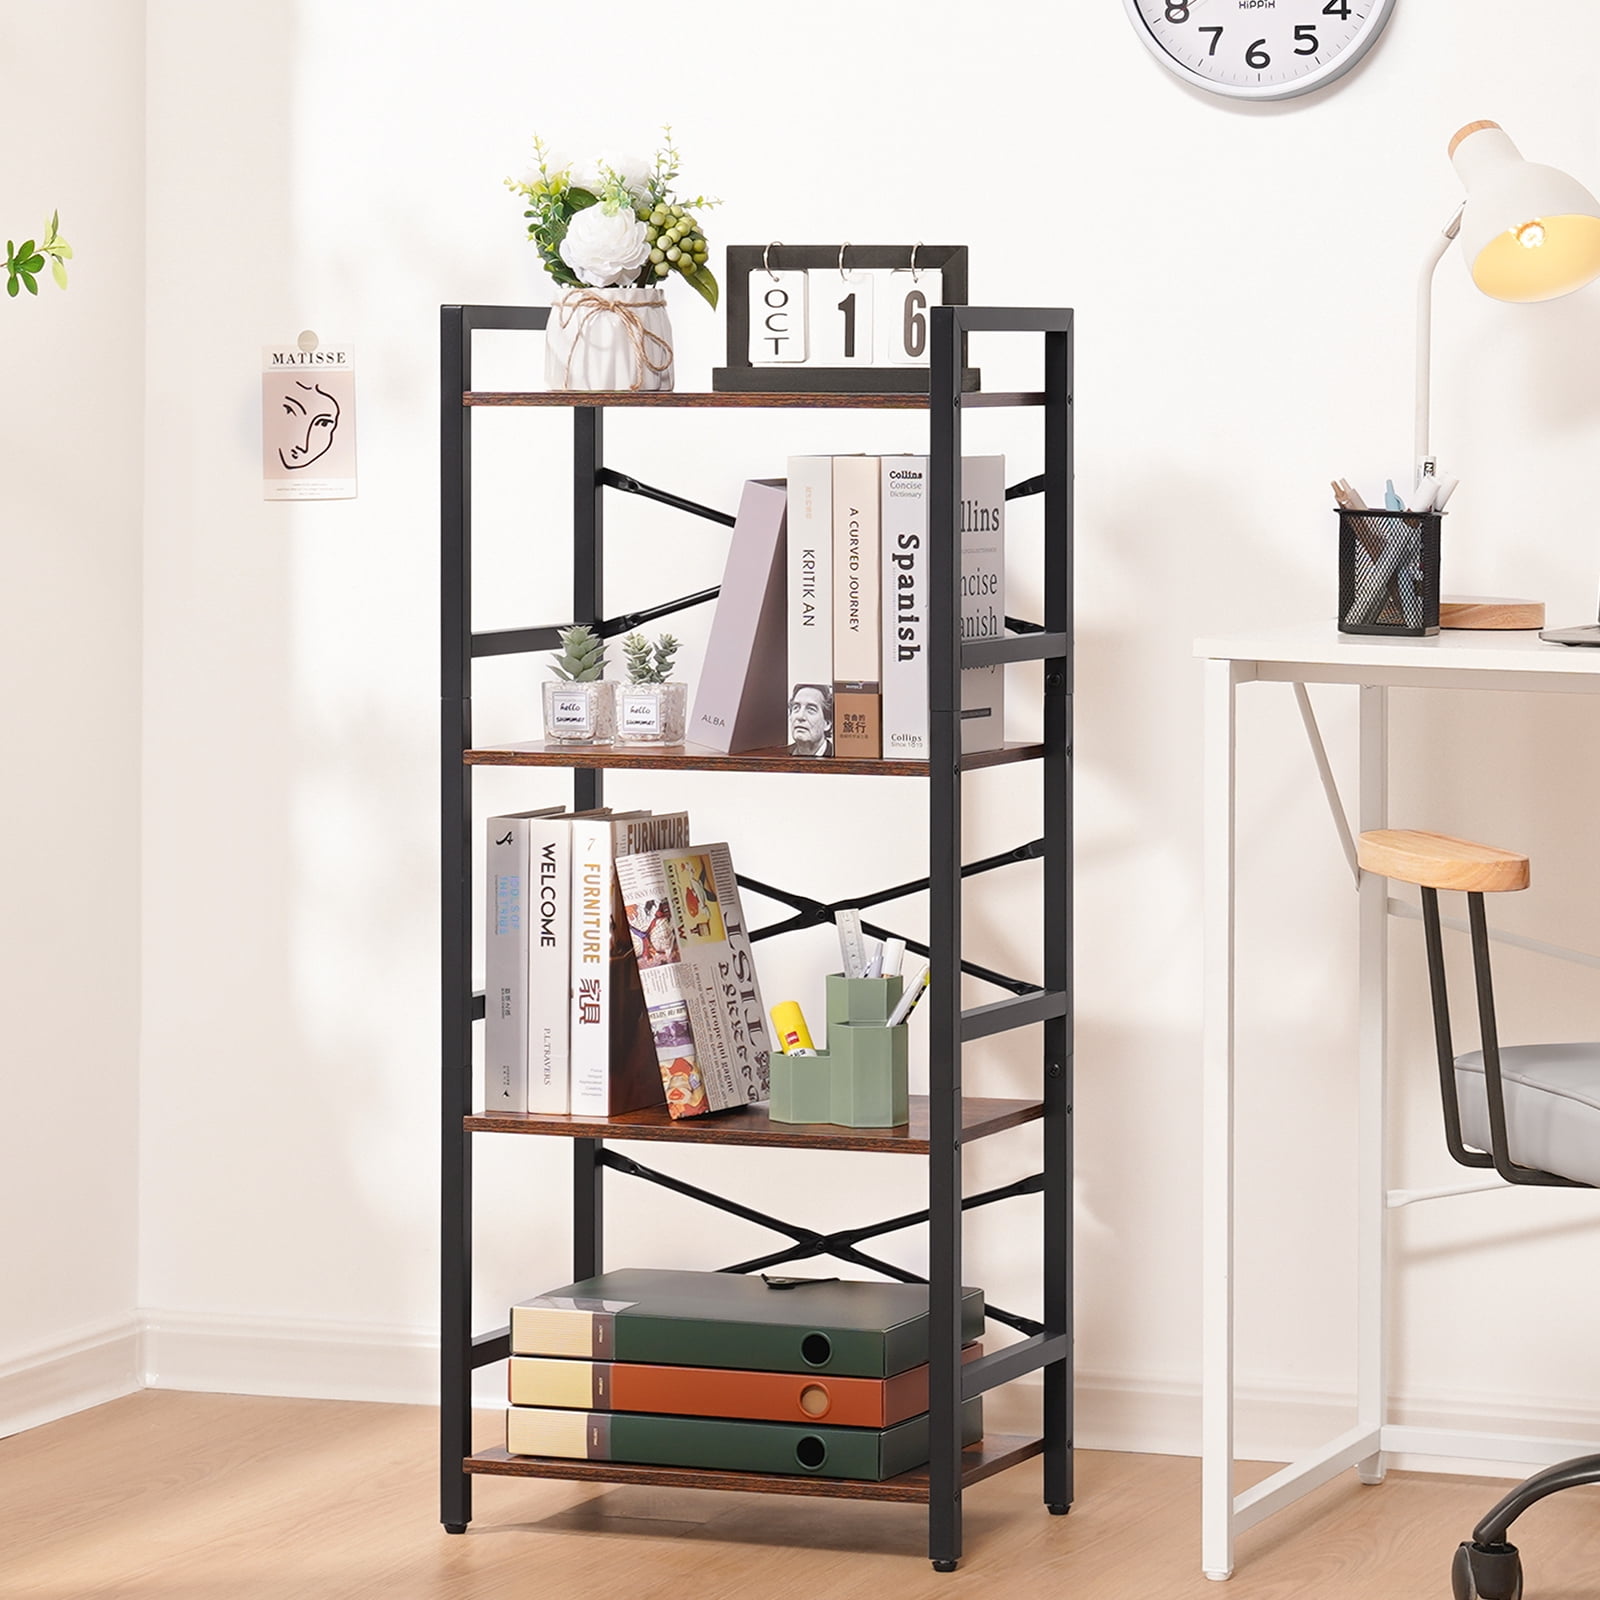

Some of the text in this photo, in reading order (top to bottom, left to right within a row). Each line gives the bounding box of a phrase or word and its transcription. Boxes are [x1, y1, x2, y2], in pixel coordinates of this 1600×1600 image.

[1322, 0, 1351, 20] 4
[1198, 26, 1224, 56] 7
[1245, 38, 1271, 69] 6
[1293, 25, 1319, 55] 5
[764, 289, 789, 355] OCT
[272, 352, 346, 365] MATISSE
[889, 470, 922, 479] Collins
[890, 481, 922, 490] Concise
[961, 501, 1000, 532] llins
[849, 507, 859, 632] A CURVED JOURNEY
[892, 534, 920, 662] Spanish
[560, 703, 581, 711] hello
[701, 714, 725, 727] ALBA
[843, 722, 866, 733] 旅行
[891, 734, 922, 742] Collins
[627, 816, 690, 855] FURNITURE
[541, 843, 556, 947] WELCOME
[583, 863, 601, 964] FURNITURE
